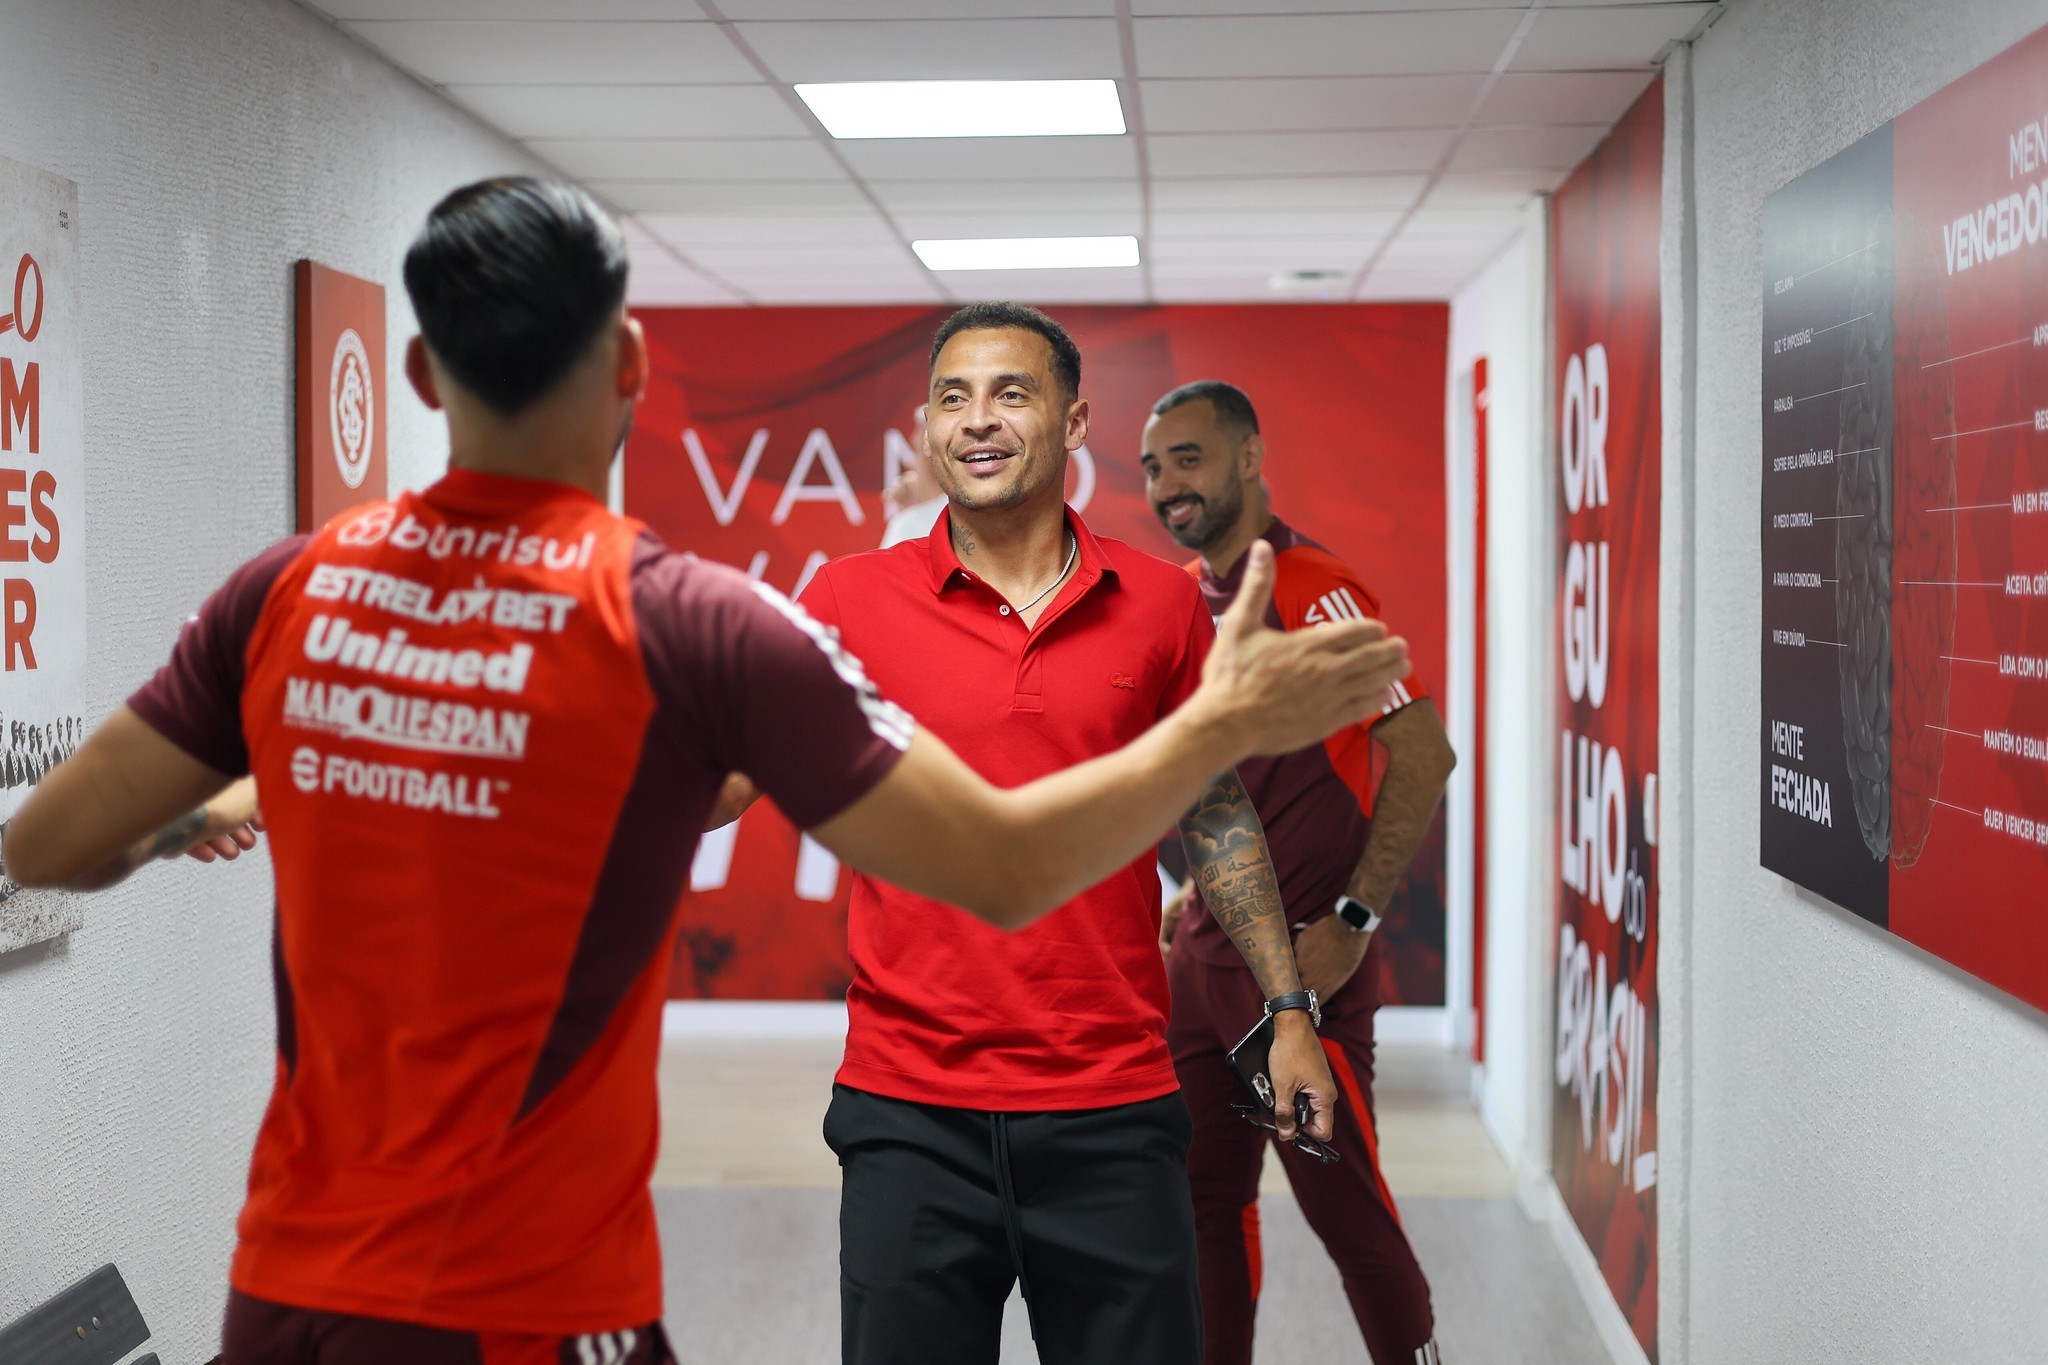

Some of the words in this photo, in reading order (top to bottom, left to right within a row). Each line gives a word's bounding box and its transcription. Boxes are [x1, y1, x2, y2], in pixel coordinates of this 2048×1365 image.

[2005, 575, 2032, 596] ACEITA
[303, 614, 534, 694] Unimed
[1999, 654, 2016, 675] LIDA
[2018, 656, 2035, 678] COM
[283, 677, 531, 758] MARQUESPAN
[1771, 719, 1804, 761] MENTE
[1984, 729, 2014, 754] MANTÉM
[1771, 763, 1832, 828] FECHADA
[1984, 807, 2004, 832] QUER
[2005, 813, 2035, 841] VENCER
